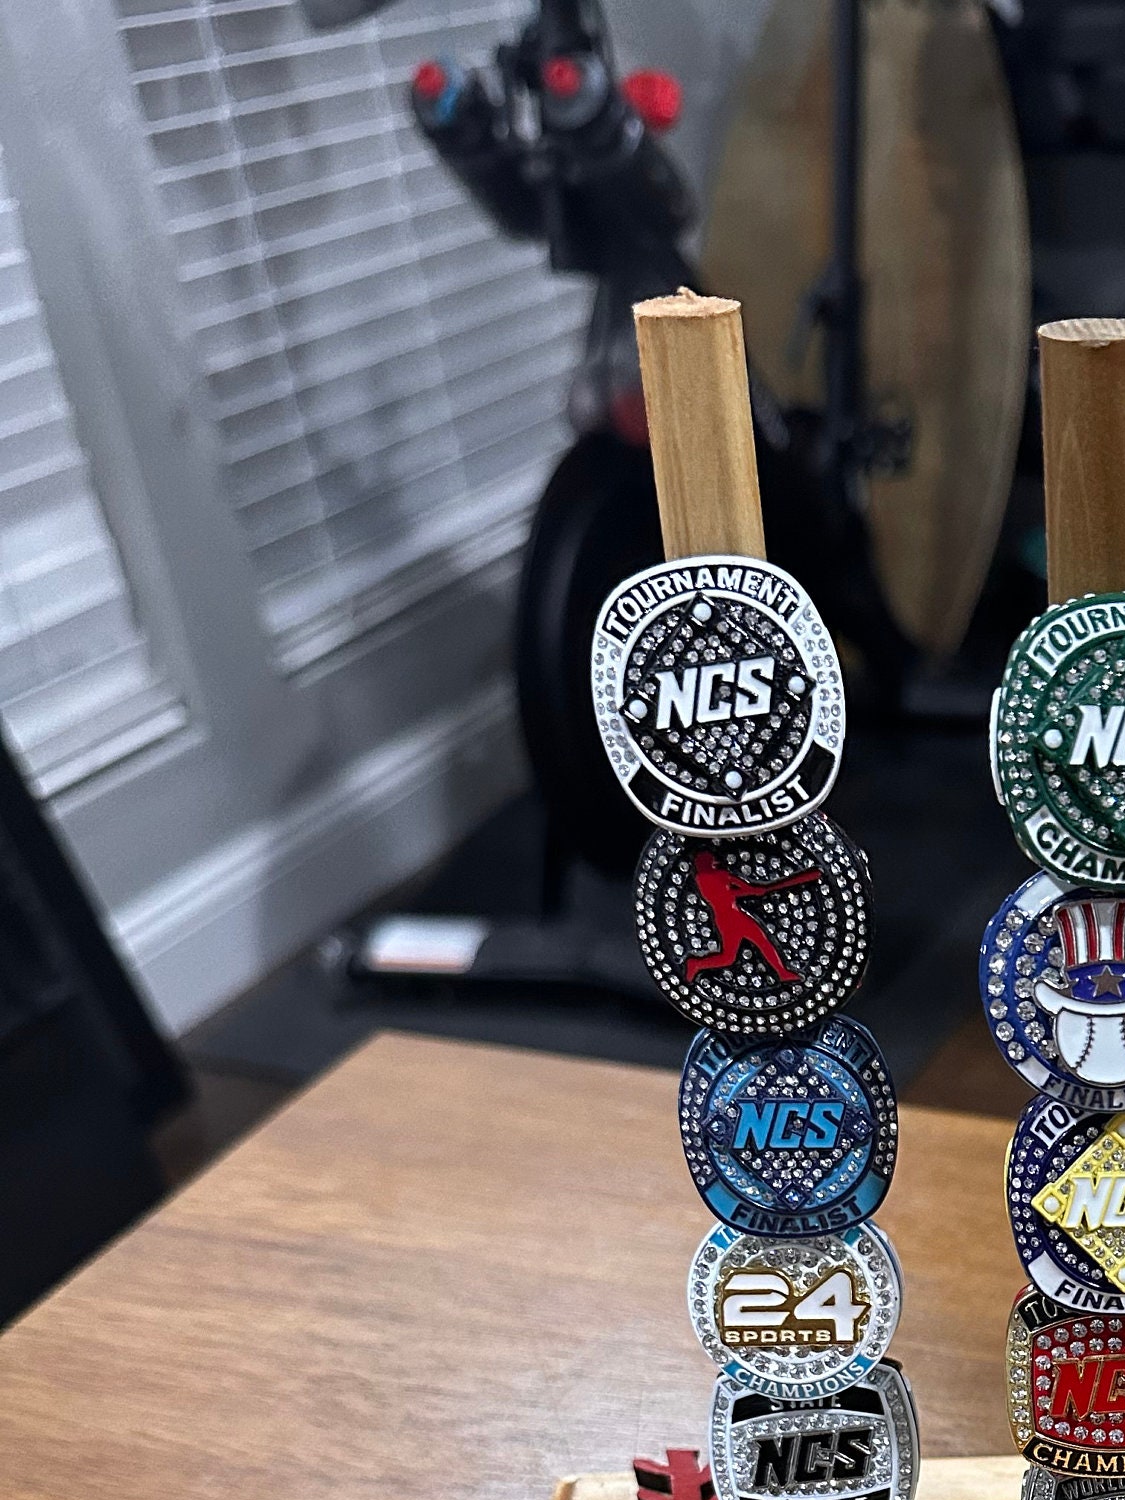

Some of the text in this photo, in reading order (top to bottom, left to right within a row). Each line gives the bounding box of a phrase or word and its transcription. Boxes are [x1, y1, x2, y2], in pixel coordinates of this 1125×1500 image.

[606, 567, 801, 638] TOURNAMENT
[655, 656, 775, 731] NCS
[660, 775, 811, 827] FINALIST
[733, 1102, 846, 1151] NCS
[729, 1195, 863, 1234] FINALIST
[722, 1271, 872, 1343] 24
[724, 1329, 832, 1344] SPORTS
[735, 1361, 865, 1398] CHAMPIONS
[753, 1429, 873, 1488] NCS
